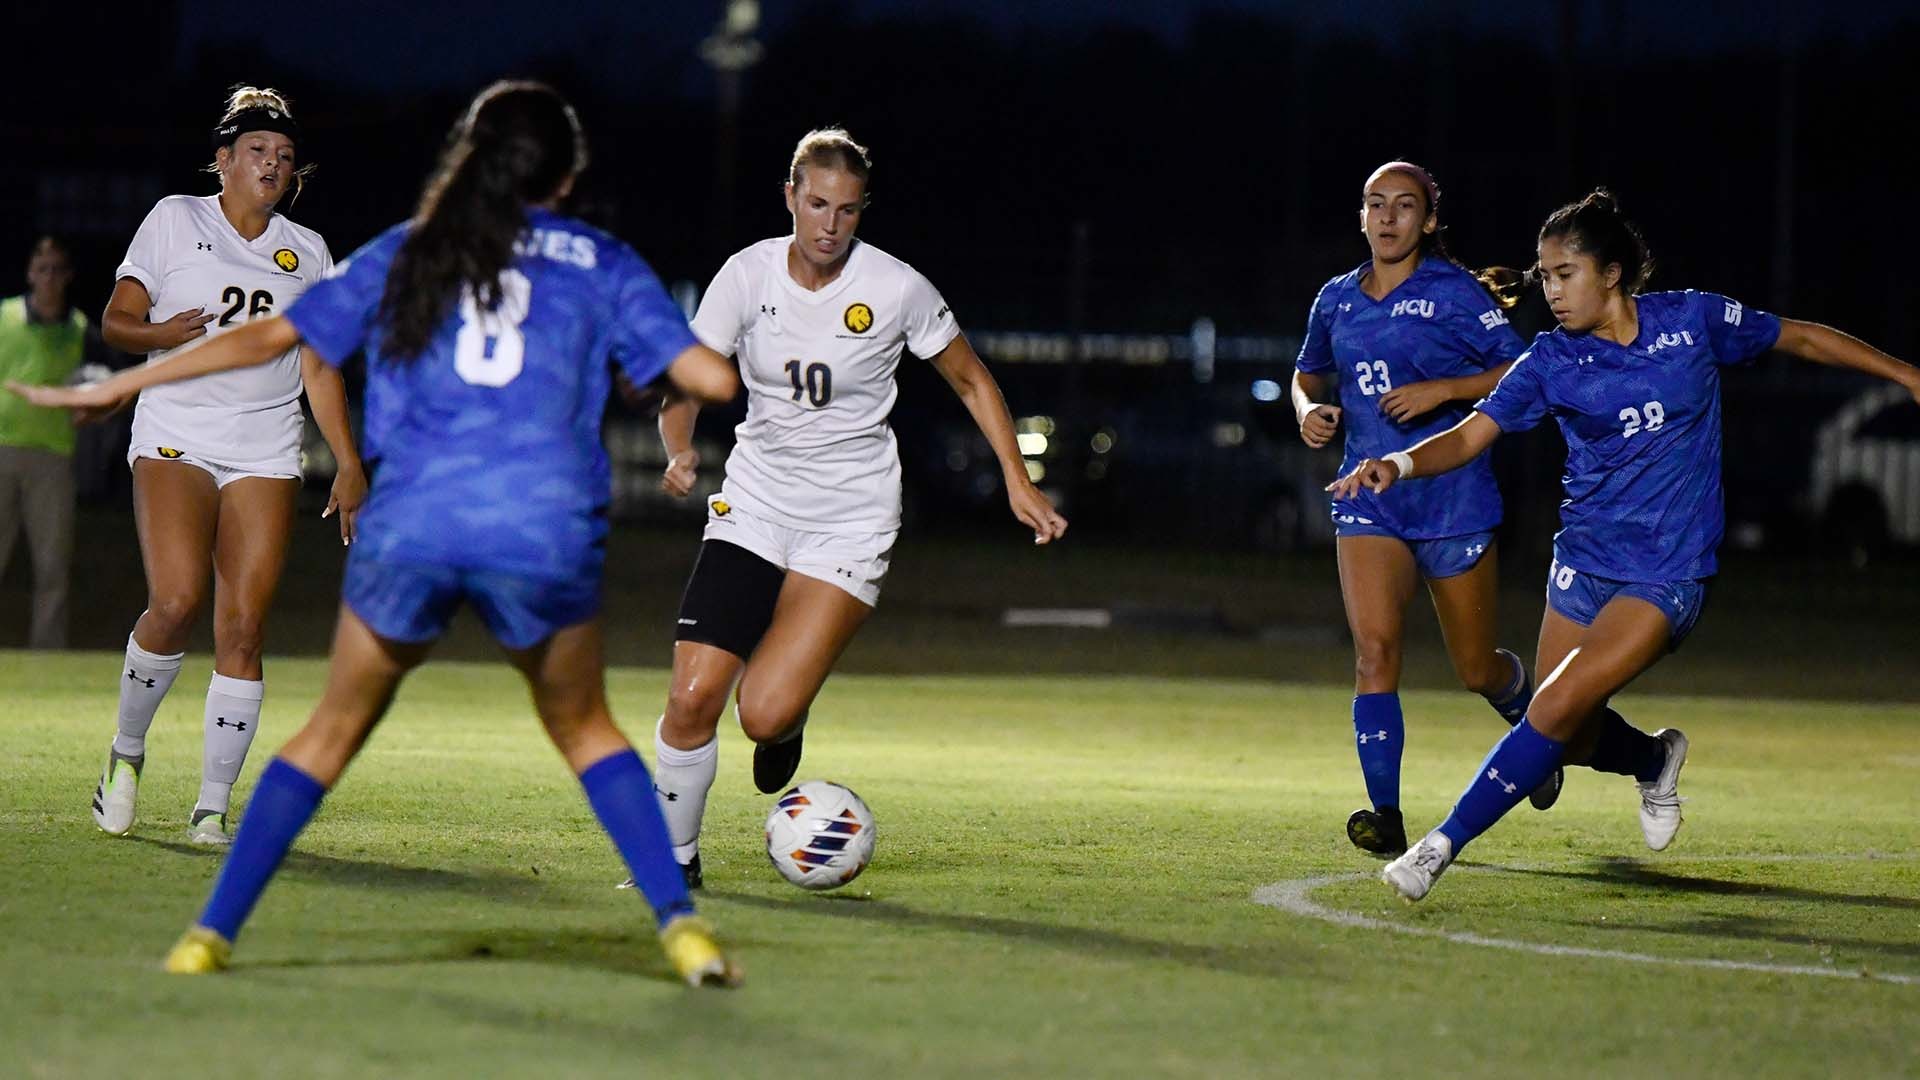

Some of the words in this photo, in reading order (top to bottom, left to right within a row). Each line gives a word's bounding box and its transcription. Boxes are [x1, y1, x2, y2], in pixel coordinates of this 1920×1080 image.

[218, 285, 274, 328] 26
[1390, 298, 1436, 319] HCU
[454, 268, 532, 388] 8
[784, 358, 833, 408] 10
[1355, 358, 1393, 396] 23
[1619, 400, 1666, 438] 28
